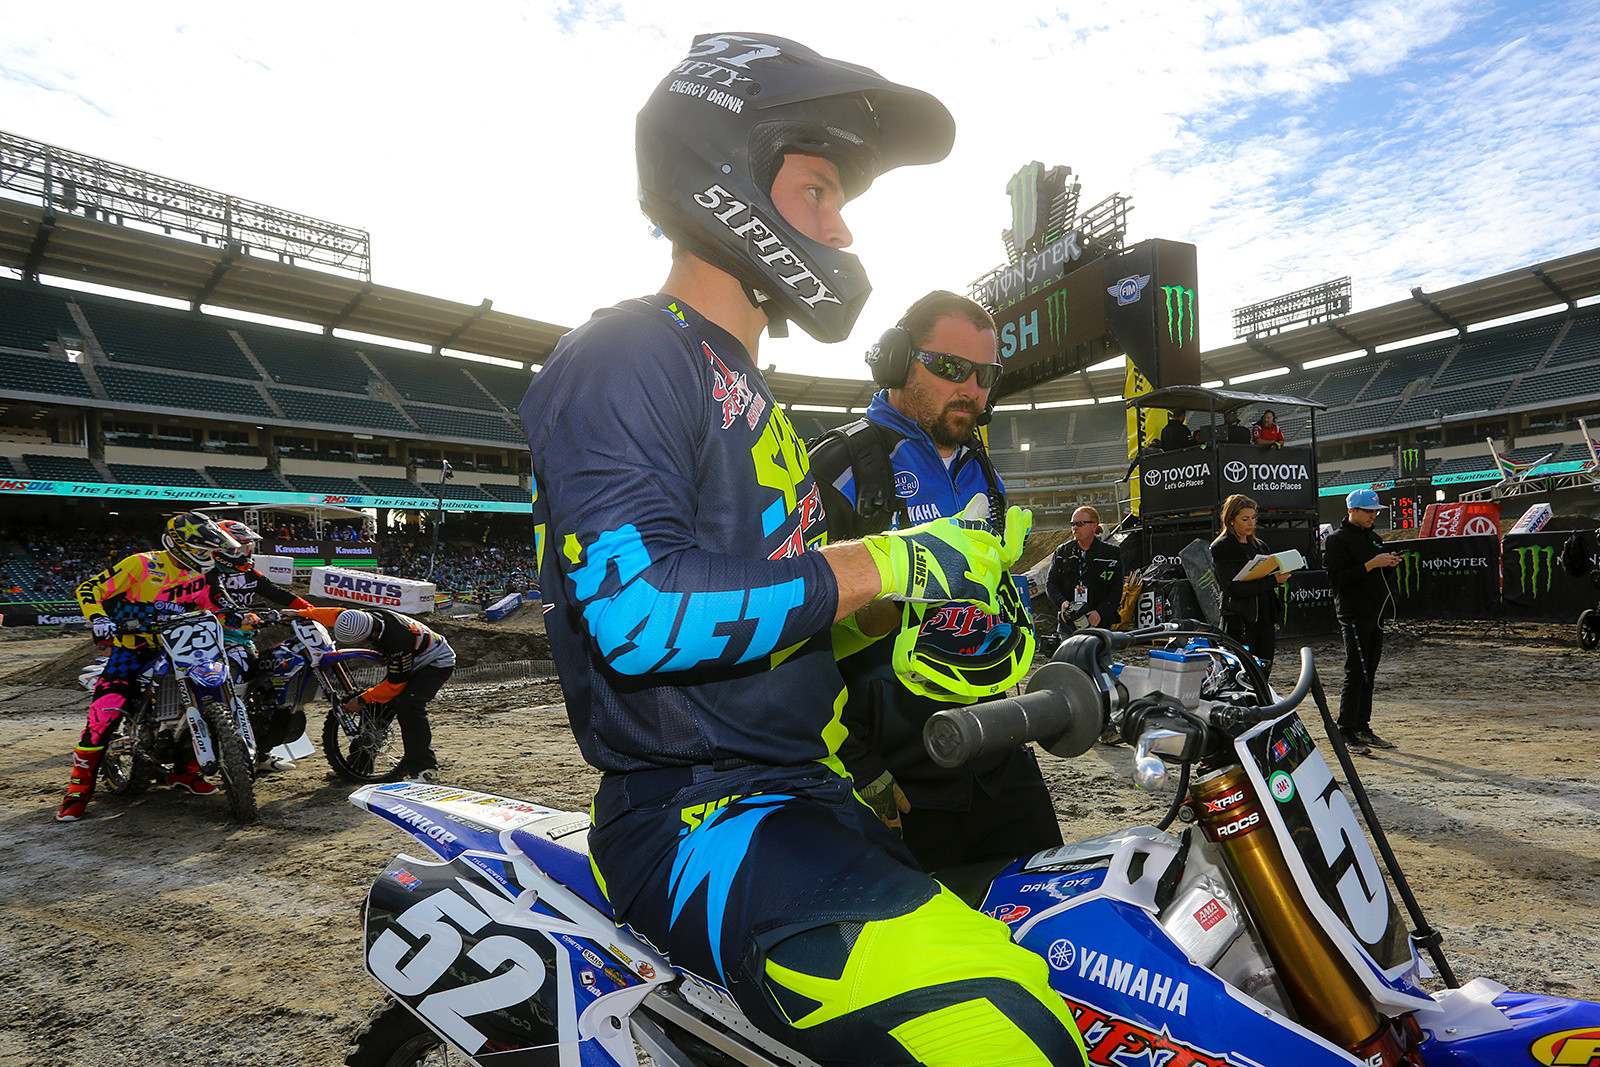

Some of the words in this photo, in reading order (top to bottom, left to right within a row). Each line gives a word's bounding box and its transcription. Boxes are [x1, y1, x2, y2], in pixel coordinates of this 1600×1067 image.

[673, 59, 754, 88] IFTY
[669, 80, 709, 98] ENERGY
[706, 88, 744, 114] DRINK
[693, 183, 842, 308] 51FIFTY
[1121, 283, 1136, 295] FIM
[1162, 463, 1211, 482] TOYOTA
[1250, 464, 1309, 480] TOYOTA
[1455, 472, 1499, 482] Synthetic
[72, 485, 100, 494] The
[104, 486, 140, 496] First
[144, 488, 158, 496] in
[162, 489, 236, 499] Synthetics
[1164, 482, 1177, 491] Let's
[1178, 481, 1186, 489] Go
[1186, 478, 1204, 487] Places
[1253, 482, 1269, 491] Let's
[1270, 482, 1280, 490] Go
[1280, 482, 1302, 490] Places
[321, 495, 363, 504] AMSOIL
[431, 501, 479, 510] Snthetics
[907, 503, 942, 522] MAHA
[1402, 519, 1414, 529] 87
[275, 544, 319, 554] Kawasaki
[335, 546, 373, 555] Kawasaki
[914, 545, 928, 588] SHIFT
[1422, 556, 1488, 570] MONSTER
[1100, 571, 1115, 580] 47
[324, 573, 402, 598] PARTS
[1290, 588, 1333, 601] MONSTE
[323, 586, 401, 607] UNLIMITED
[37, 614, 88, 625] Kawas
[170, 621, 219, 652] 23
[1203, 790, 1244, 812] XTRIG
[388, 803, 458, 845] DUNLOP
[1216, 812, 1260, 837] ROCS
[1291, 748, 1389, 945] 5
[386, 868, 423, 891] AMA
[1020, 881, 1061, 893] DAVE
[1062, 876, 1095, 888] DYE
[1199, 902, 1218, 921] AMA
[583, 949, 604, 967] EVANS
[368, 887, 546, 1056] 52
[1080, 946, 1189, 1016] YAMAHA
